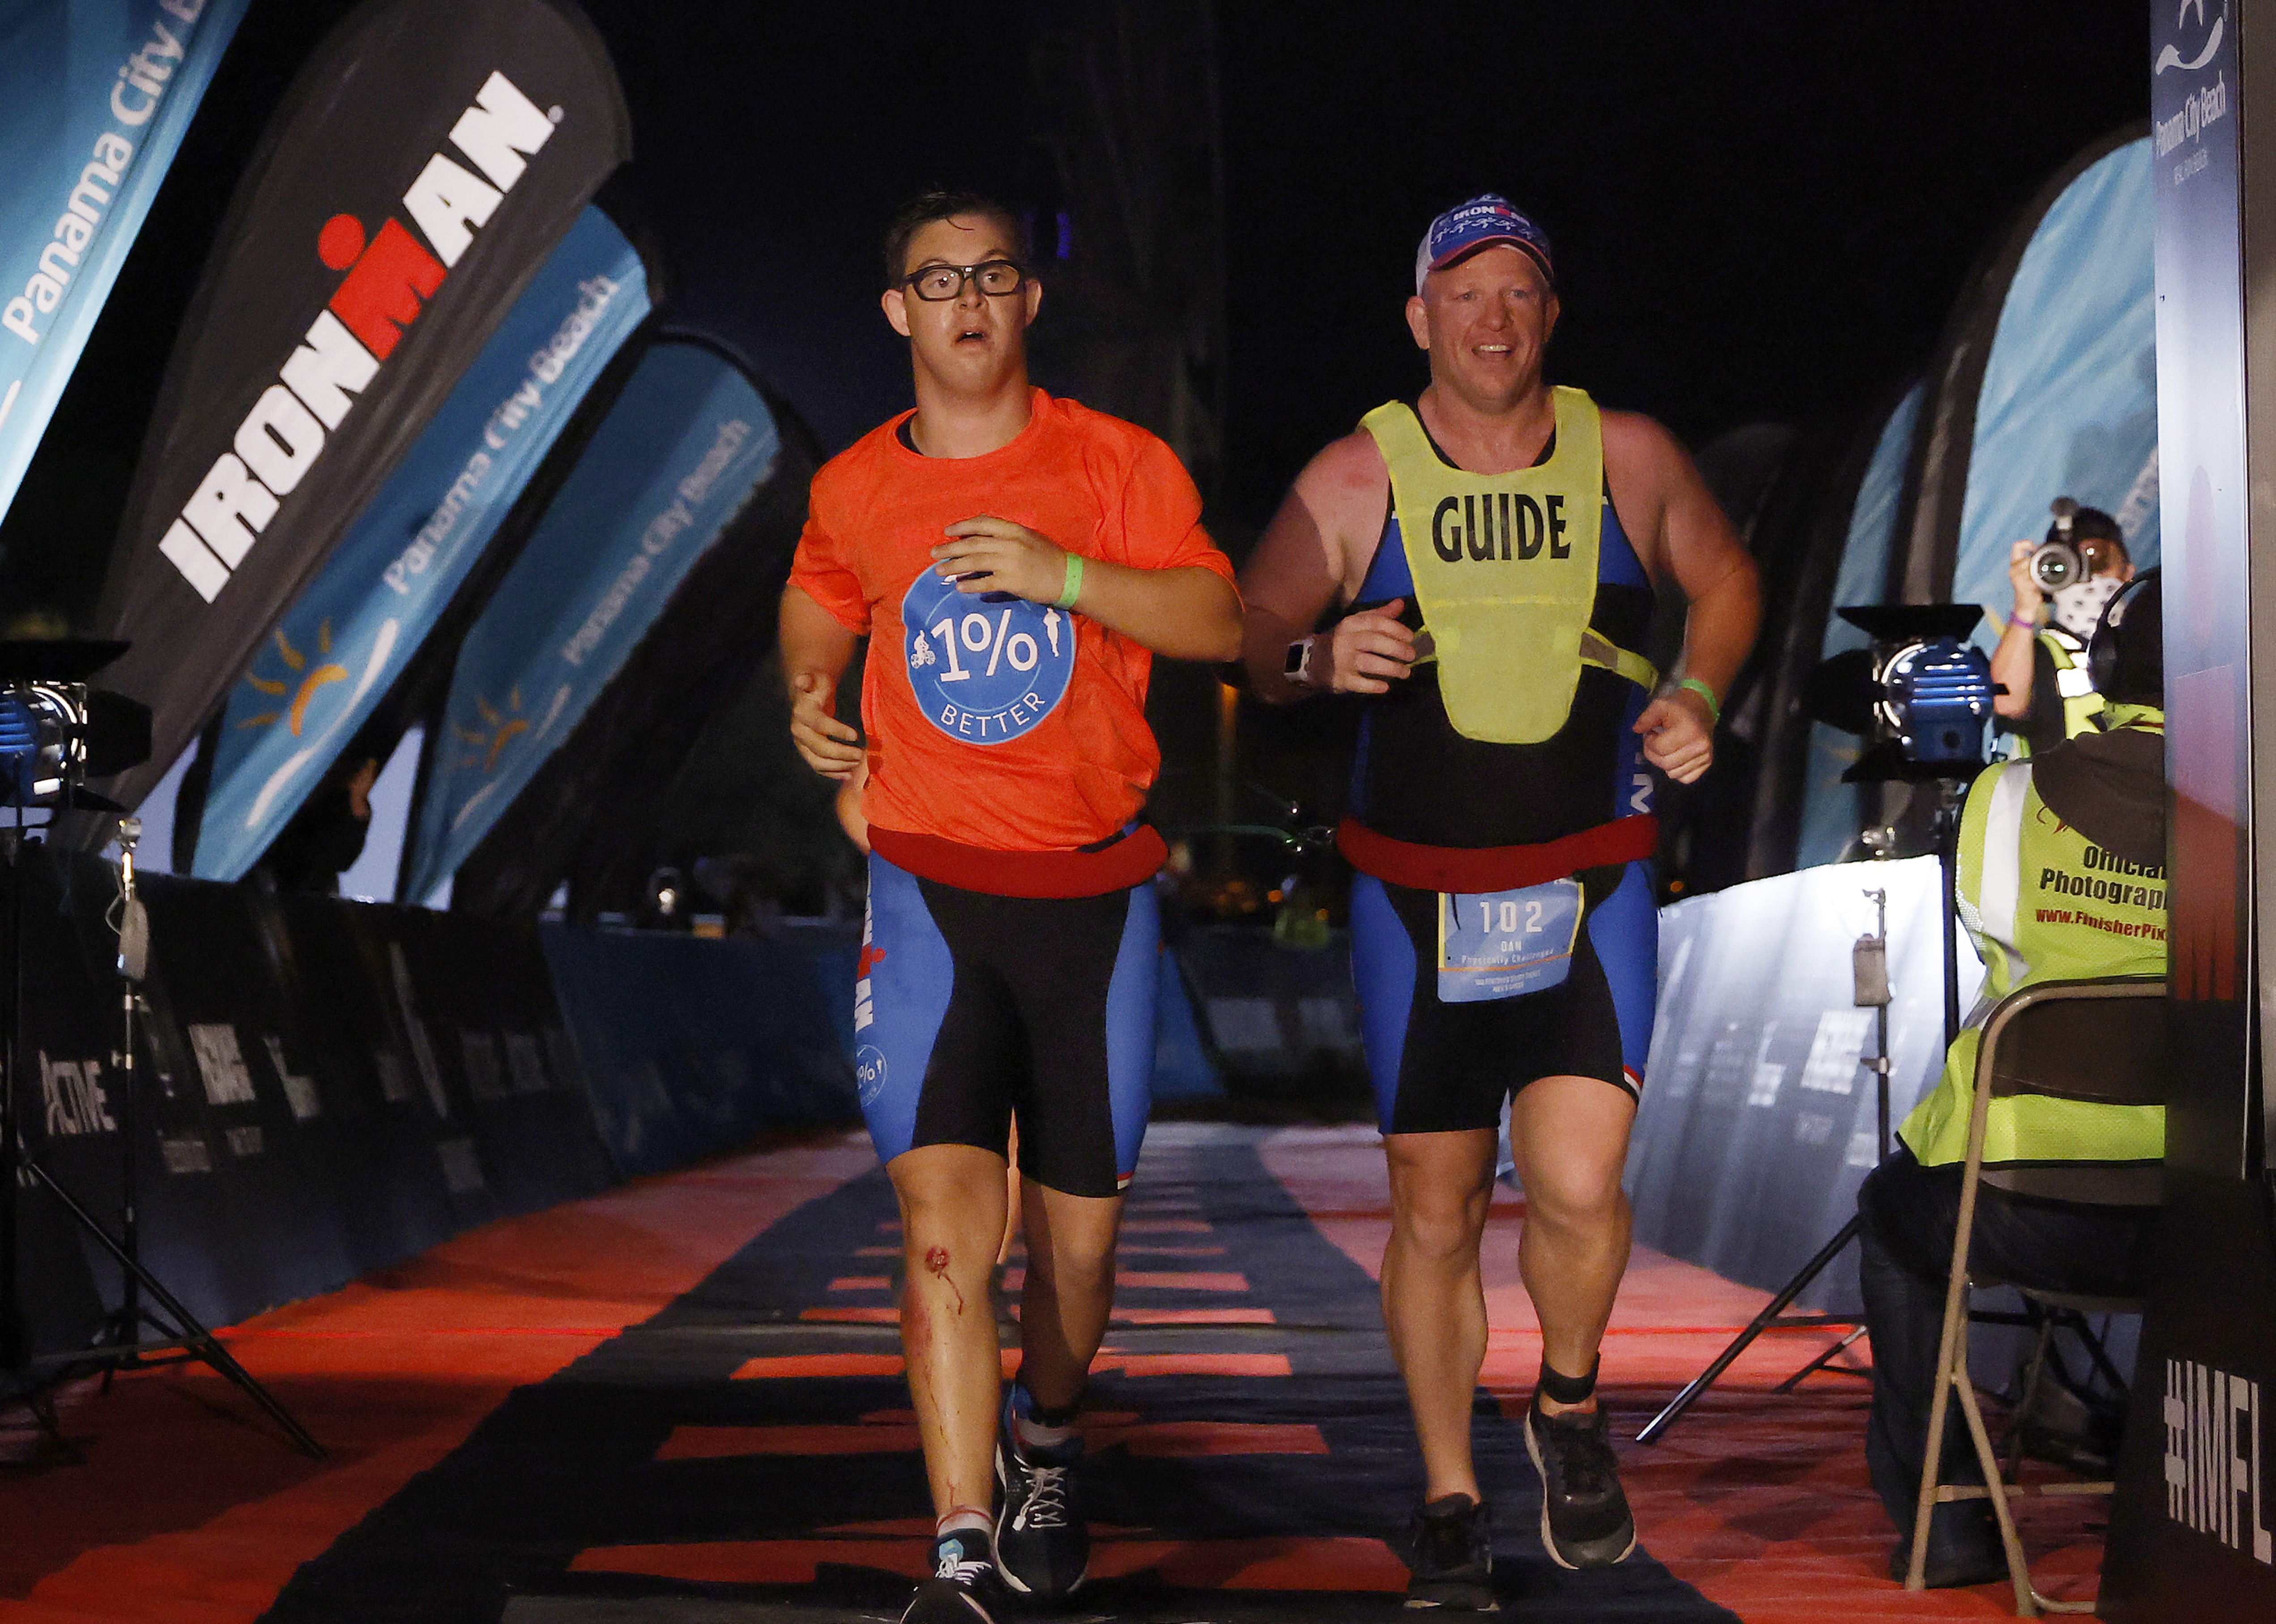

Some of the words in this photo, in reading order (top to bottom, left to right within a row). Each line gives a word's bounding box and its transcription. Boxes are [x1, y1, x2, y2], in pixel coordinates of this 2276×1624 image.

[2201, 69, 2226, 128] Beach
[2, 132, 133, 345] Panama
[110, 21, 184, 126] City
[158, 69, 556, 604] IRONMAN
[383, 452, 491, 595] Panama
[1433, 493, 1571, 563] GUIDE
[931, 609, 1038, 682] 1%
[940, 692, 1046, 736] BETTER
[1479, 900, 1543, 933] 102
[2040, 867, 2166, 910] Photograp
[1501, 941, 1522, 952] DAN
[2164, 1358, 2272, 1564] #IMFL
